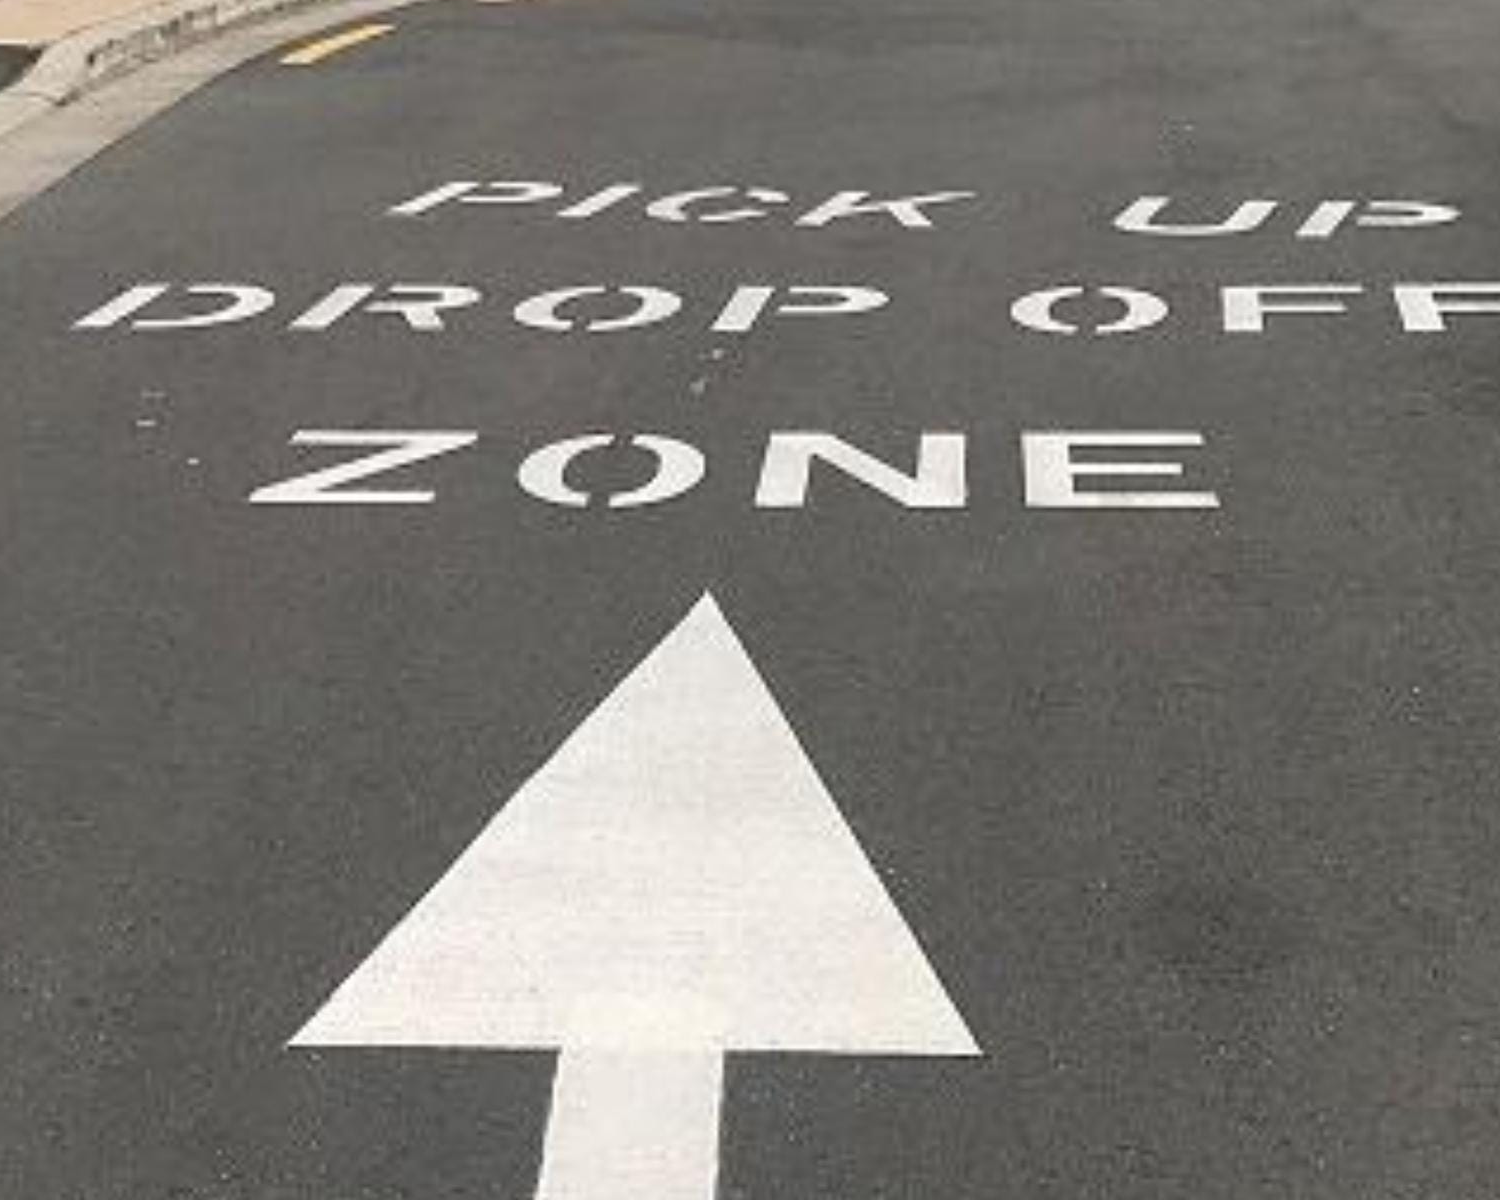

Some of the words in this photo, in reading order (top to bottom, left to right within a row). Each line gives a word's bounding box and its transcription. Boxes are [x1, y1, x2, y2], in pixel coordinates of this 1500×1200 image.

[387, 181, 976, 228] PICK
[1113, 196, 1461, 237] UP
[71, 282, 890, 333] DROP
[248, 429, 1221, 508] ZONE
